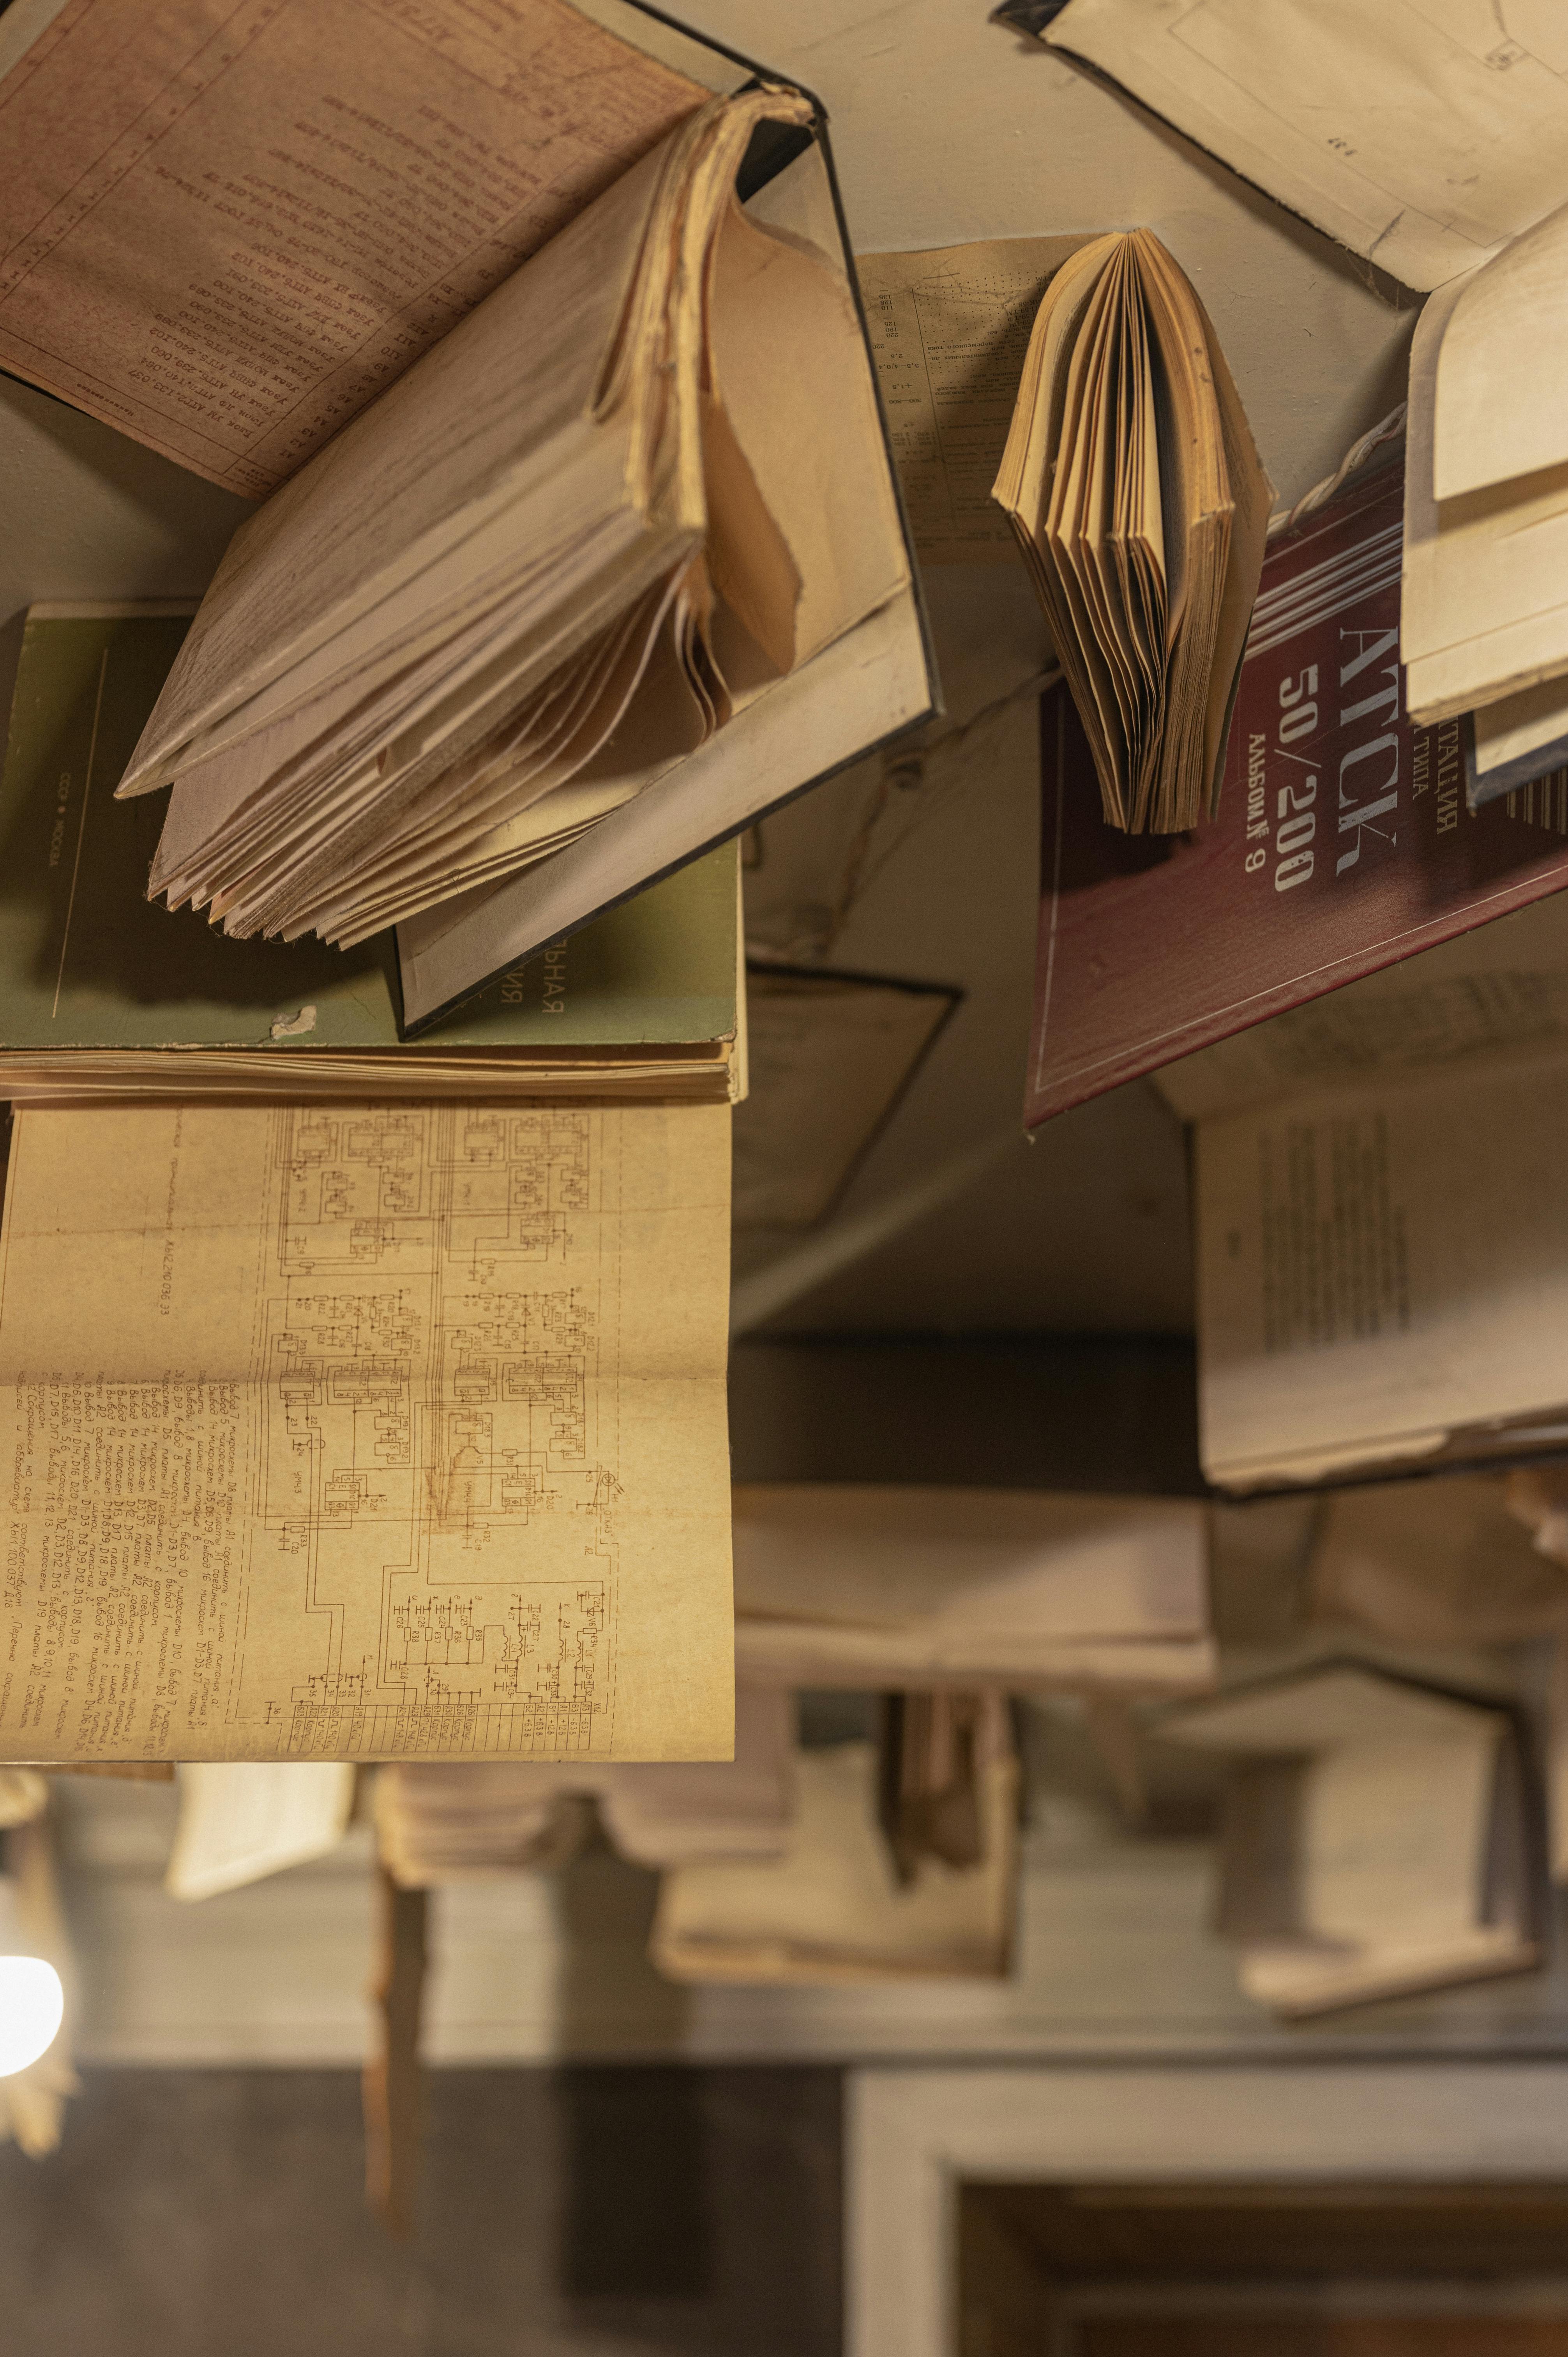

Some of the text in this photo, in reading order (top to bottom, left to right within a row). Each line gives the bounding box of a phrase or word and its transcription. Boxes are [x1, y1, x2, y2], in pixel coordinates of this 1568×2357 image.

[308, 346, 335, 362] Узел
[320, 335, 348, 352] Узел
[283, 365, 312, 382] Узел
[295, 355, 324, 372] Узел
[260, 386, 288, 405] Узел
[272, 375, 300, 393] Узел
[247, 398, 276, 416] Узел
[226, 420, 254, 438] Блок
[1336, 625, 1399, 877] АТСК
[1247, 733, 1266, 824] АЛЬБОМ
[1274, 663, 1322, 892] 50/200
[1413, 735, 1429, 800] ТИПА
[1434, 717, 1459, 834] ТАЦИЯ
[48, 772, 71, 868] СССР МОСКВА
[1245, 852, 1266, 873] 9
[151, 1387, 161, 1418] Вывод
[197, 1369, 207, 1415] соединить
[208, 1385, 218, 1415] Вывод
[219, 1385, 230, 1414] Вывод
[229, 1383, 240, 1410] Вывод
[25, 1395, 38, 1455] Сокращения
[96, 1405, 106, 1418] А2
[209, 1420, 218, 1429] 14
[151, 1424, 160, 1434] 14
[163, 1427, 172, 1440] D5
[95, 1426, 106, 1481] соединить
[147, 1441, 157, 1491] микросхем
[196, 1441, 205, 1473] шиной
[205, 1434, 216, 1483] микросхем
[215, 1431, 226, 1486] микросхемы
[226, 1426, 236, 1477] микросхемы
[25, 1465, 33, 1477] на
[161, 1488, 170, 1499] А1
[217, 1492, 227, 1507] D10
[228, 1482, 237, 1493] D8
[90, 1503, 99, 1533] шиной
[193, 1484, 202, 1527] питания
[225, 1496, 233, 1524] платы
[156, 1504, 167, 1555] соединить
[214, 1512, 222, 1546] платы
[225, 1530, 236, 1540] А1
[13, 1523, 29, 1607] соответствуют
[87, 1543, 97, 1587] питания
[144, 1534, 153, 1568] платы
[202, 1539, 214, 1568] вывод
[214, 1550, 224, 1561] А1
[142, 1576, 153, 1587] А2
[202, 1573, 211, 1581] 16
[222, 1546, 233, 1594] соединить
[209, 1569, 221, 1618] соединить
[137, 1595, 149, 1644] соединить
[196, 1589, 208, 1636] микросхем
[218, 1615, 227, 1643] шиной
[205, 1640, 214, 1669] шиной
[132, 1661, 143, 1690] шиной
[213, 1654, 223, 1692] питания
[188, 1689, 198, 1717] платы
[200, 1678, 210, 1716] питания
[124, 1698, 137, 1732] питания
[439, 1718, 452, 1740] Корпус
[451, 1718, 463, 1741] Корпус
[462, 1718, 474, 1741] Корпус
